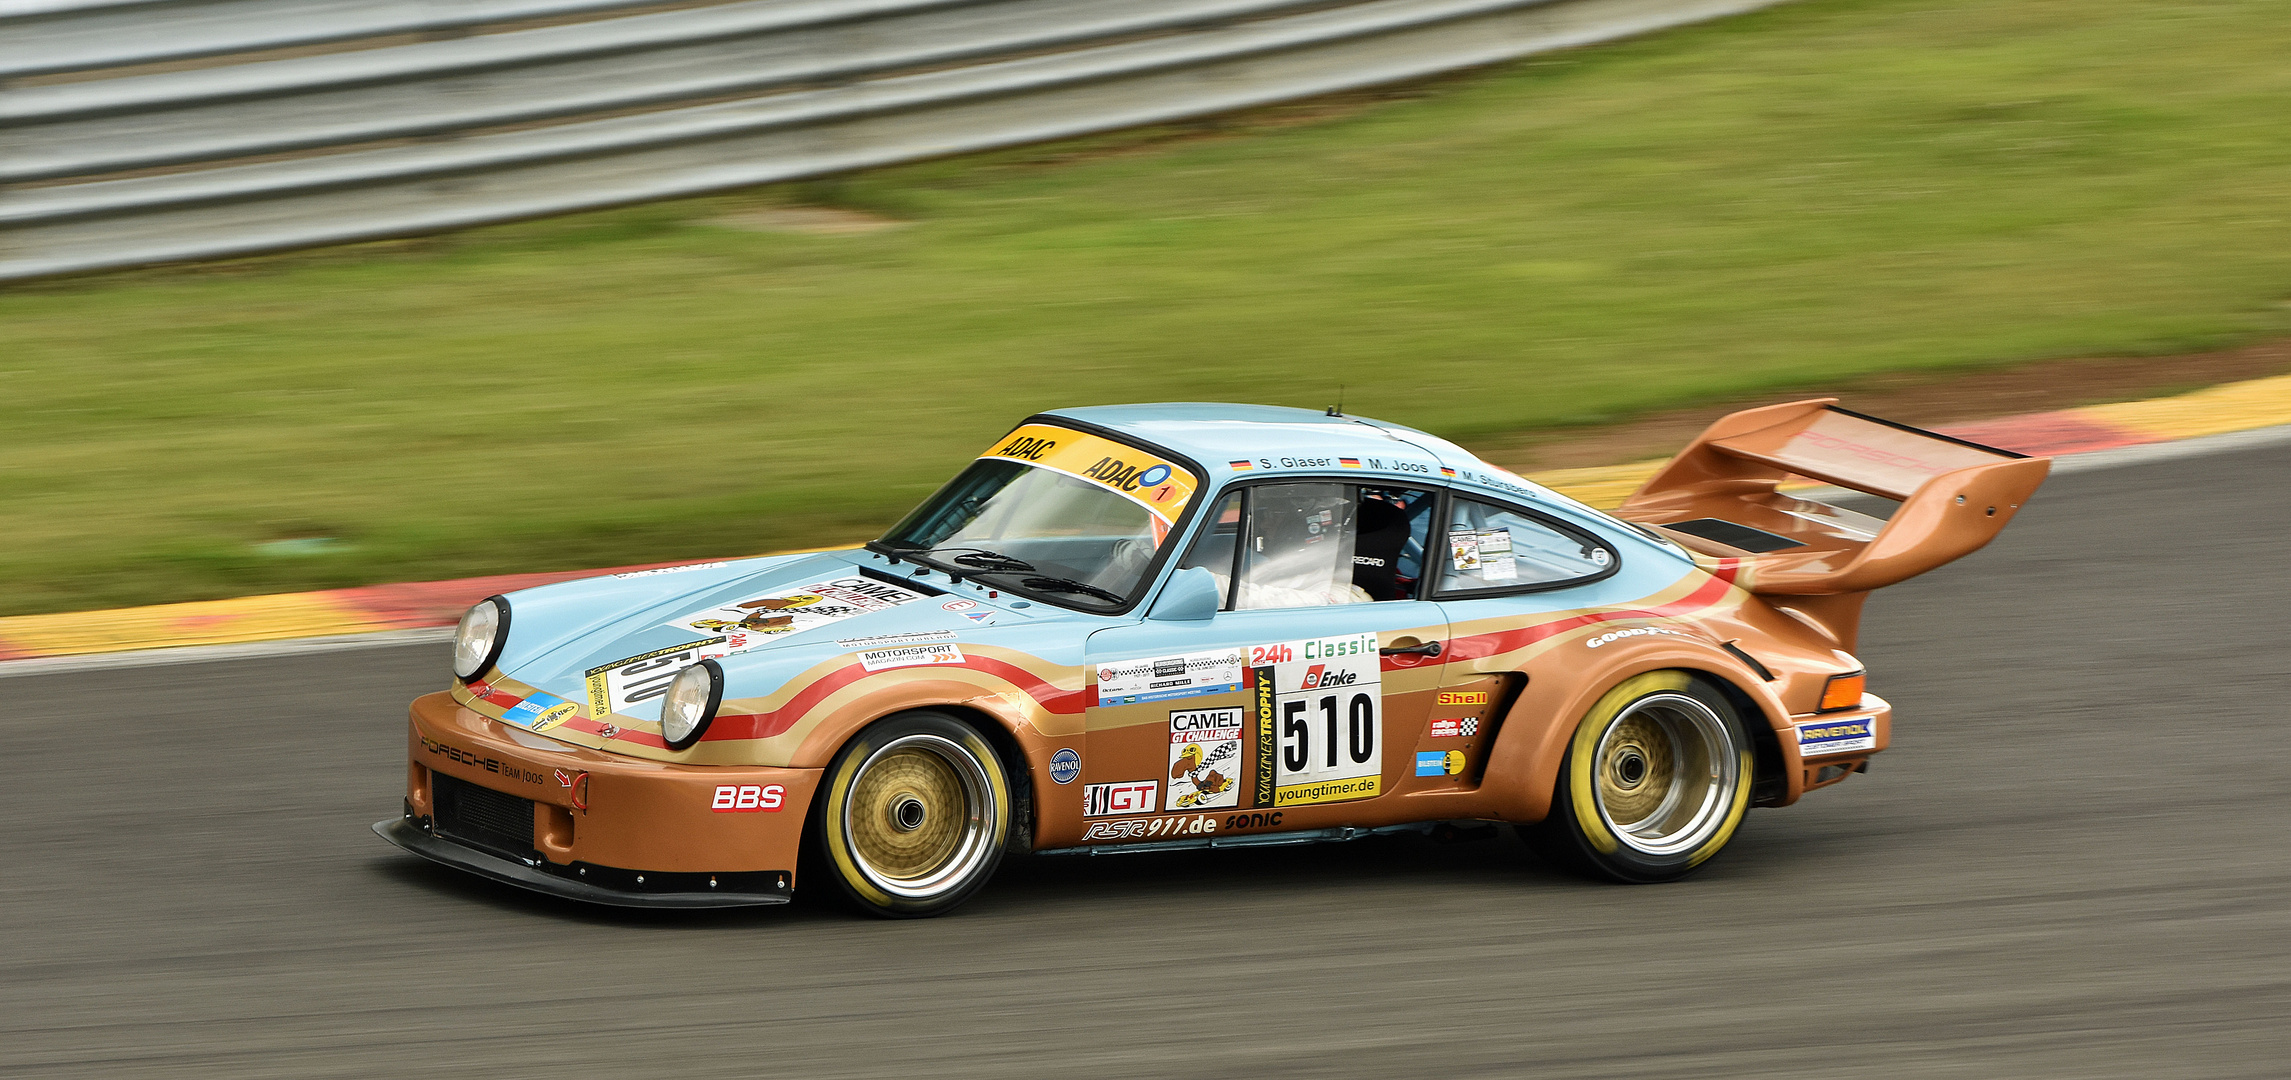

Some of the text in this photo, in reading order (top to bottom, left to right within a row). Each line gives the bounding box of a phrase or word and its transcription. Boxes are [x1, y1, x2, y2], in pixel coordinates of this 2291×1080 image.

[997, 436, 1056, 461] ADAC
[1261, 456, 1331, 470] S. Glaser
[1368, 458, 1429, 474] M. Joos
[1083, 457, 1146, 492] ADAC
[1462, 470, 1477, 482] M.
[1156, 485, 1171, 501] 1
[865, 645, 952, 660] MOTORSPORT
[1252, 634, 1376, 663] 24h Classic
[1319, 669, 1357, 688] Enke
[1439, 692, 1487, 704] Shell
[1173, 711, 1241, 731] CAMEL
[1172, 729, 1240, 744] GT CHALLENGE
[1258, 674, 1273, 804] YOUNGTIMERTROPHY
[1283, 692, 1374, 773] 510
[1803, 724, 1868, 740] RAVENOL
[420, 736, 499, 774] PORSCHE
[501, 762, 520, 779] TEAM
[1051, 760, 1080, 772] RAVENOL
[711, 784, 786, 811] BBS
[1111, 785, 1155, 810] GT
[1278, 779, 1375, 803] youngtimer.de
